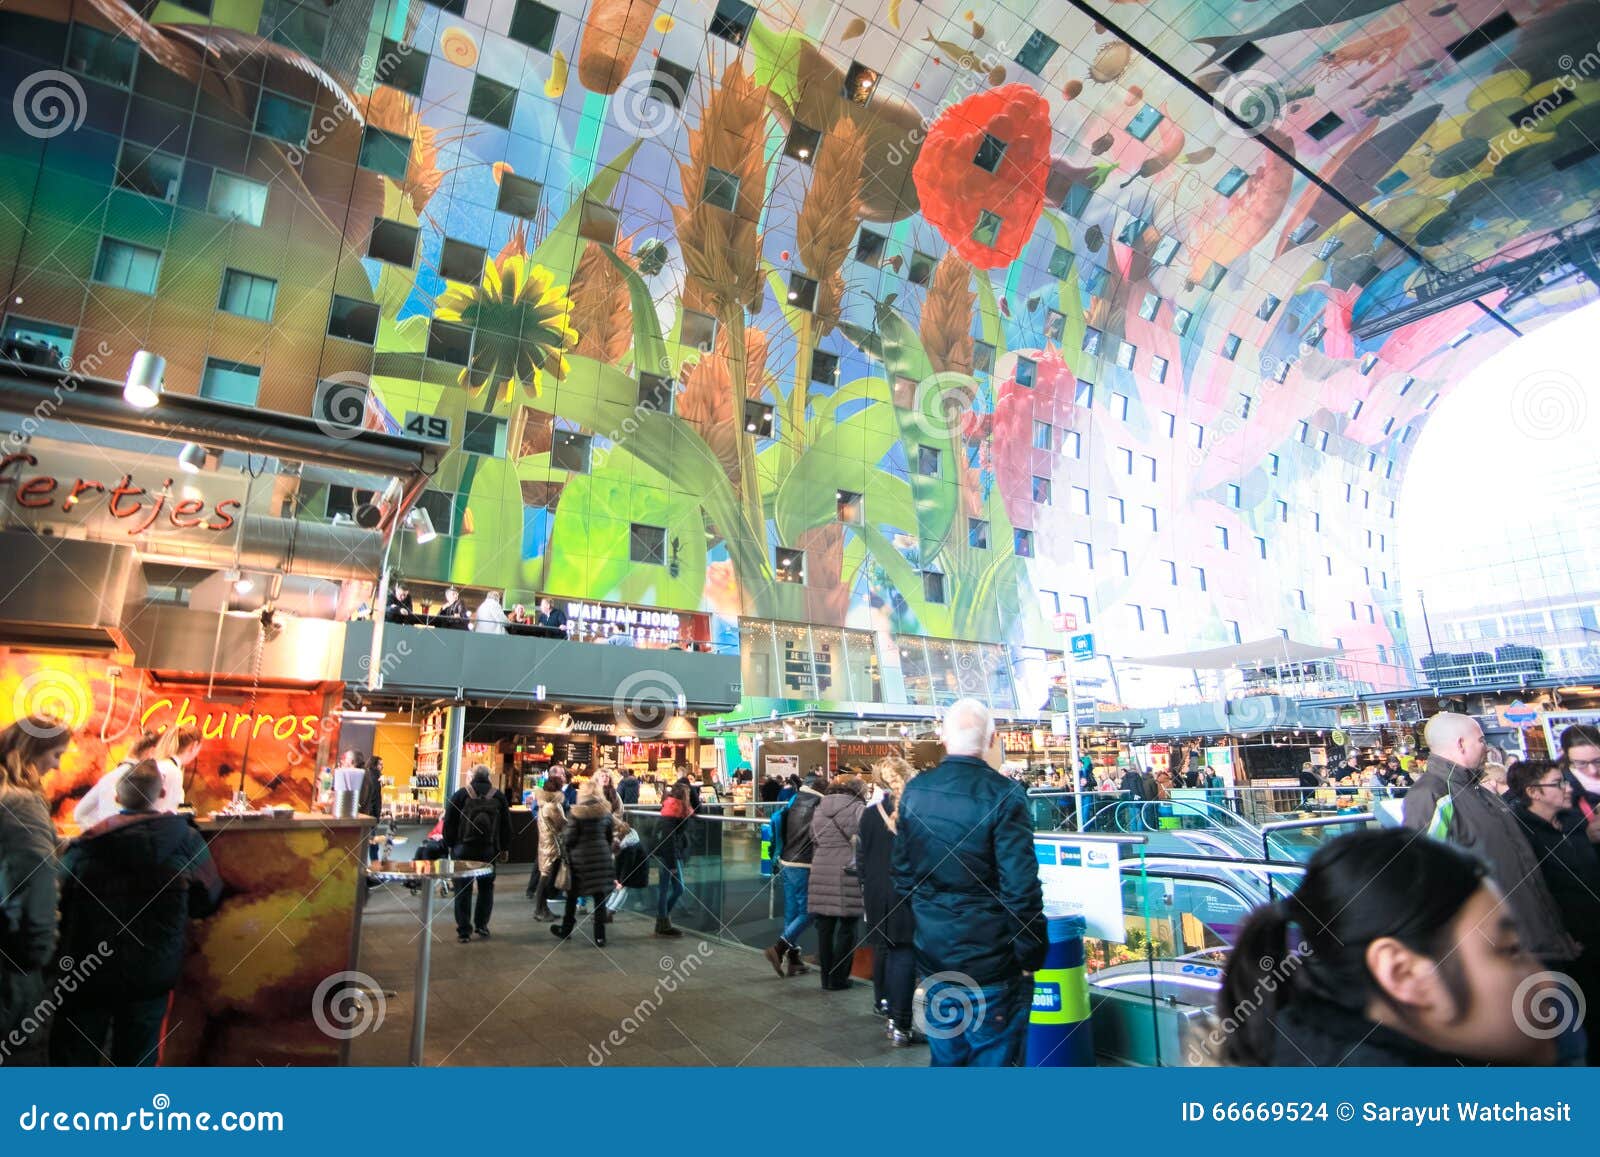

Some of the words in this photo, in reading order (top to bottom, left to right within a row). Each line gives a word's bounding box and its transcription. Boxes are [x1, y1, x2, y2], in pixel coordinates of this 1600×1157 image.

[407, 414, 447, 439] 49
[140, 697, 319, 740] Churros
[840, 744, 873, 756] FAMILY
